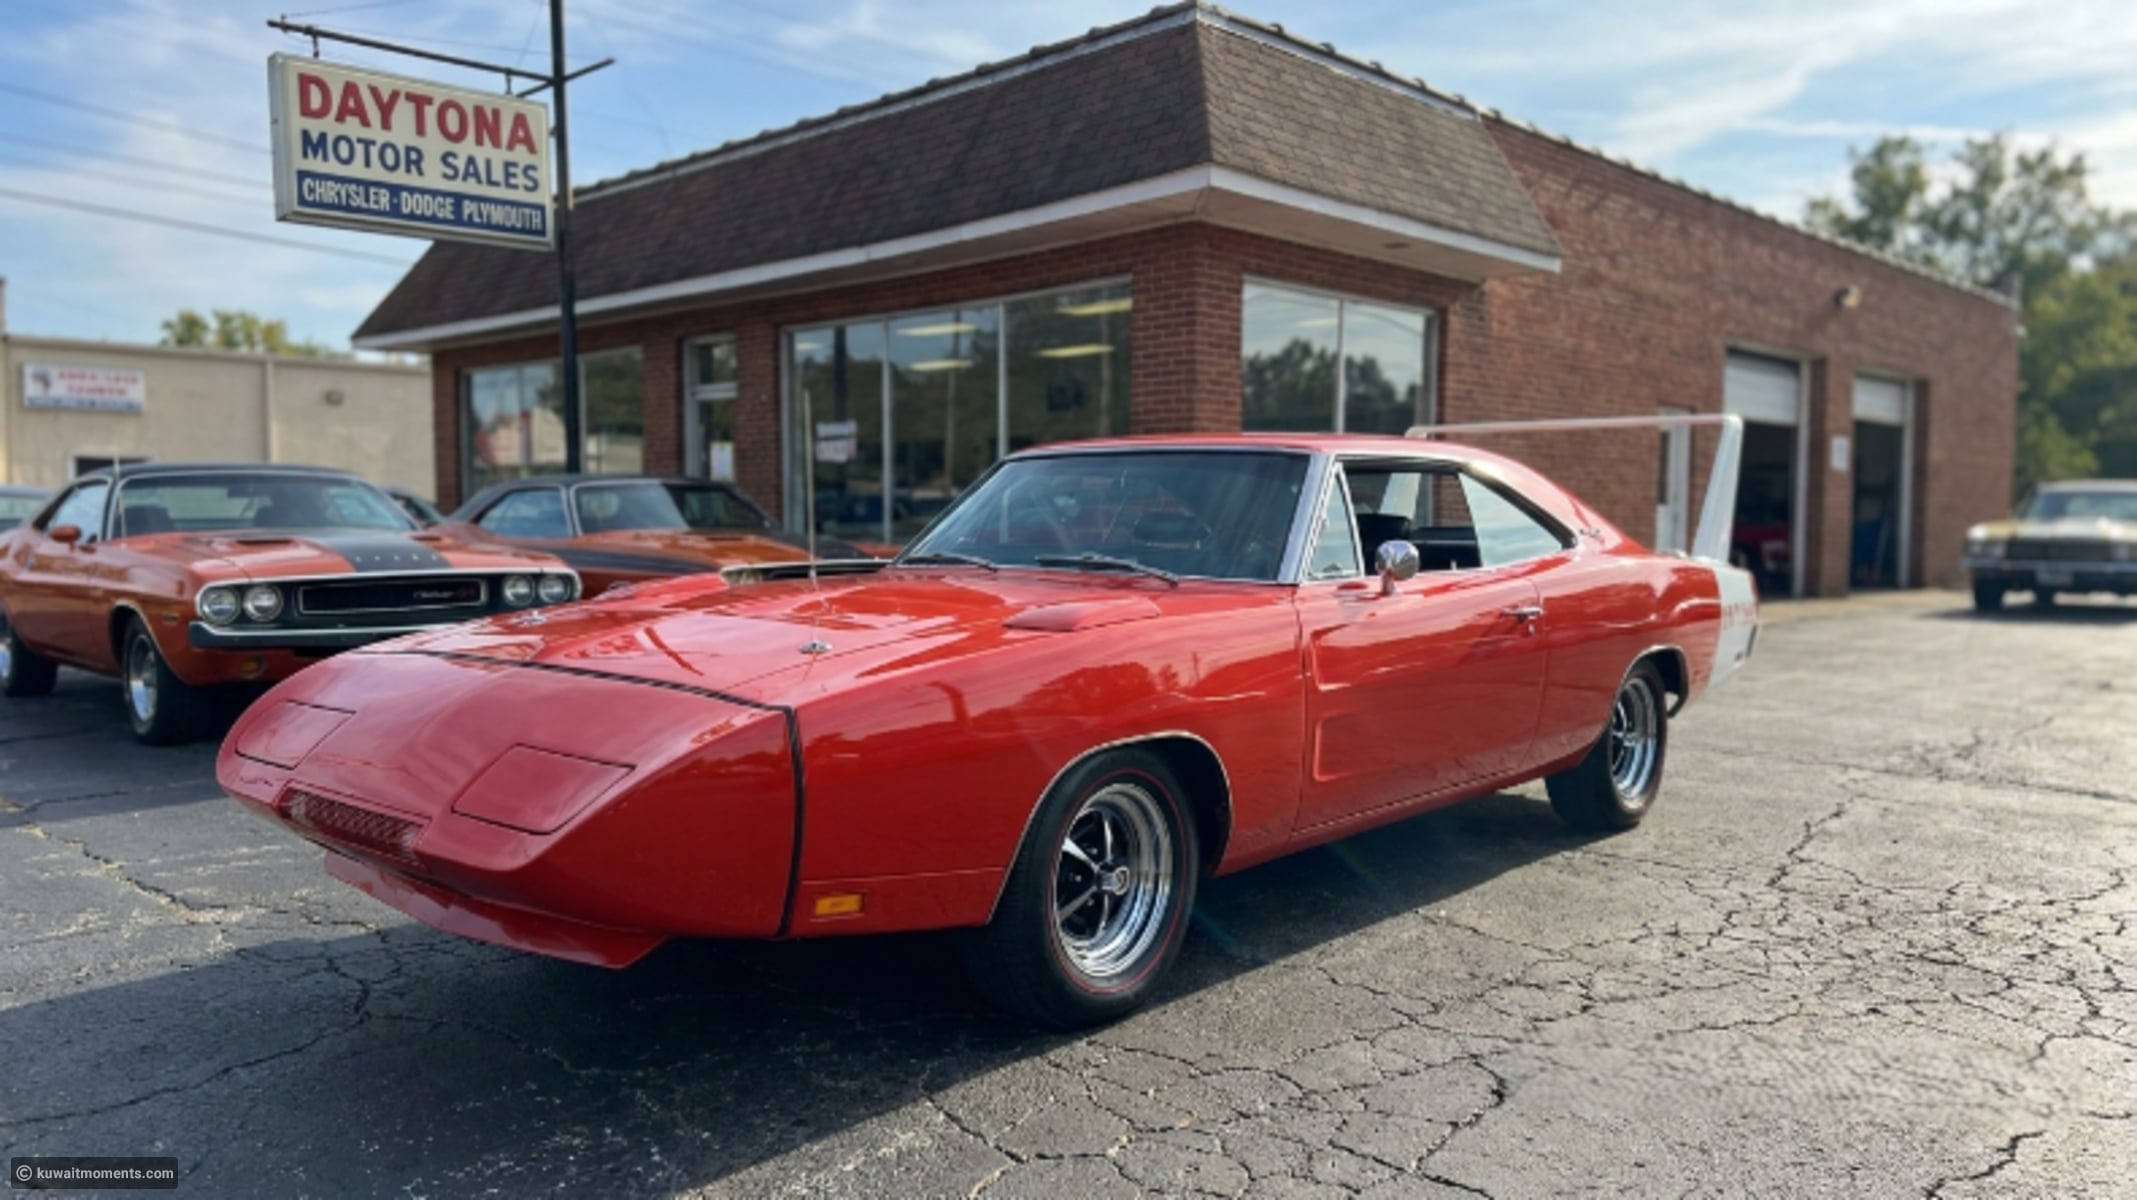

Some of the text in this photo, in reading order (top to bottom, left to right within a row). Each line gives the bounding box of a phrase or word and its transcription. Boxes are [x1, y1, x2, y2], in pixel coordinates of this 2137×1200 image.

[298, 72, 538, 155] DAYTONA
[301, 129, 540, 193] MOTOR SALES
[462, 200, 542, 231] PLYMOUTH
